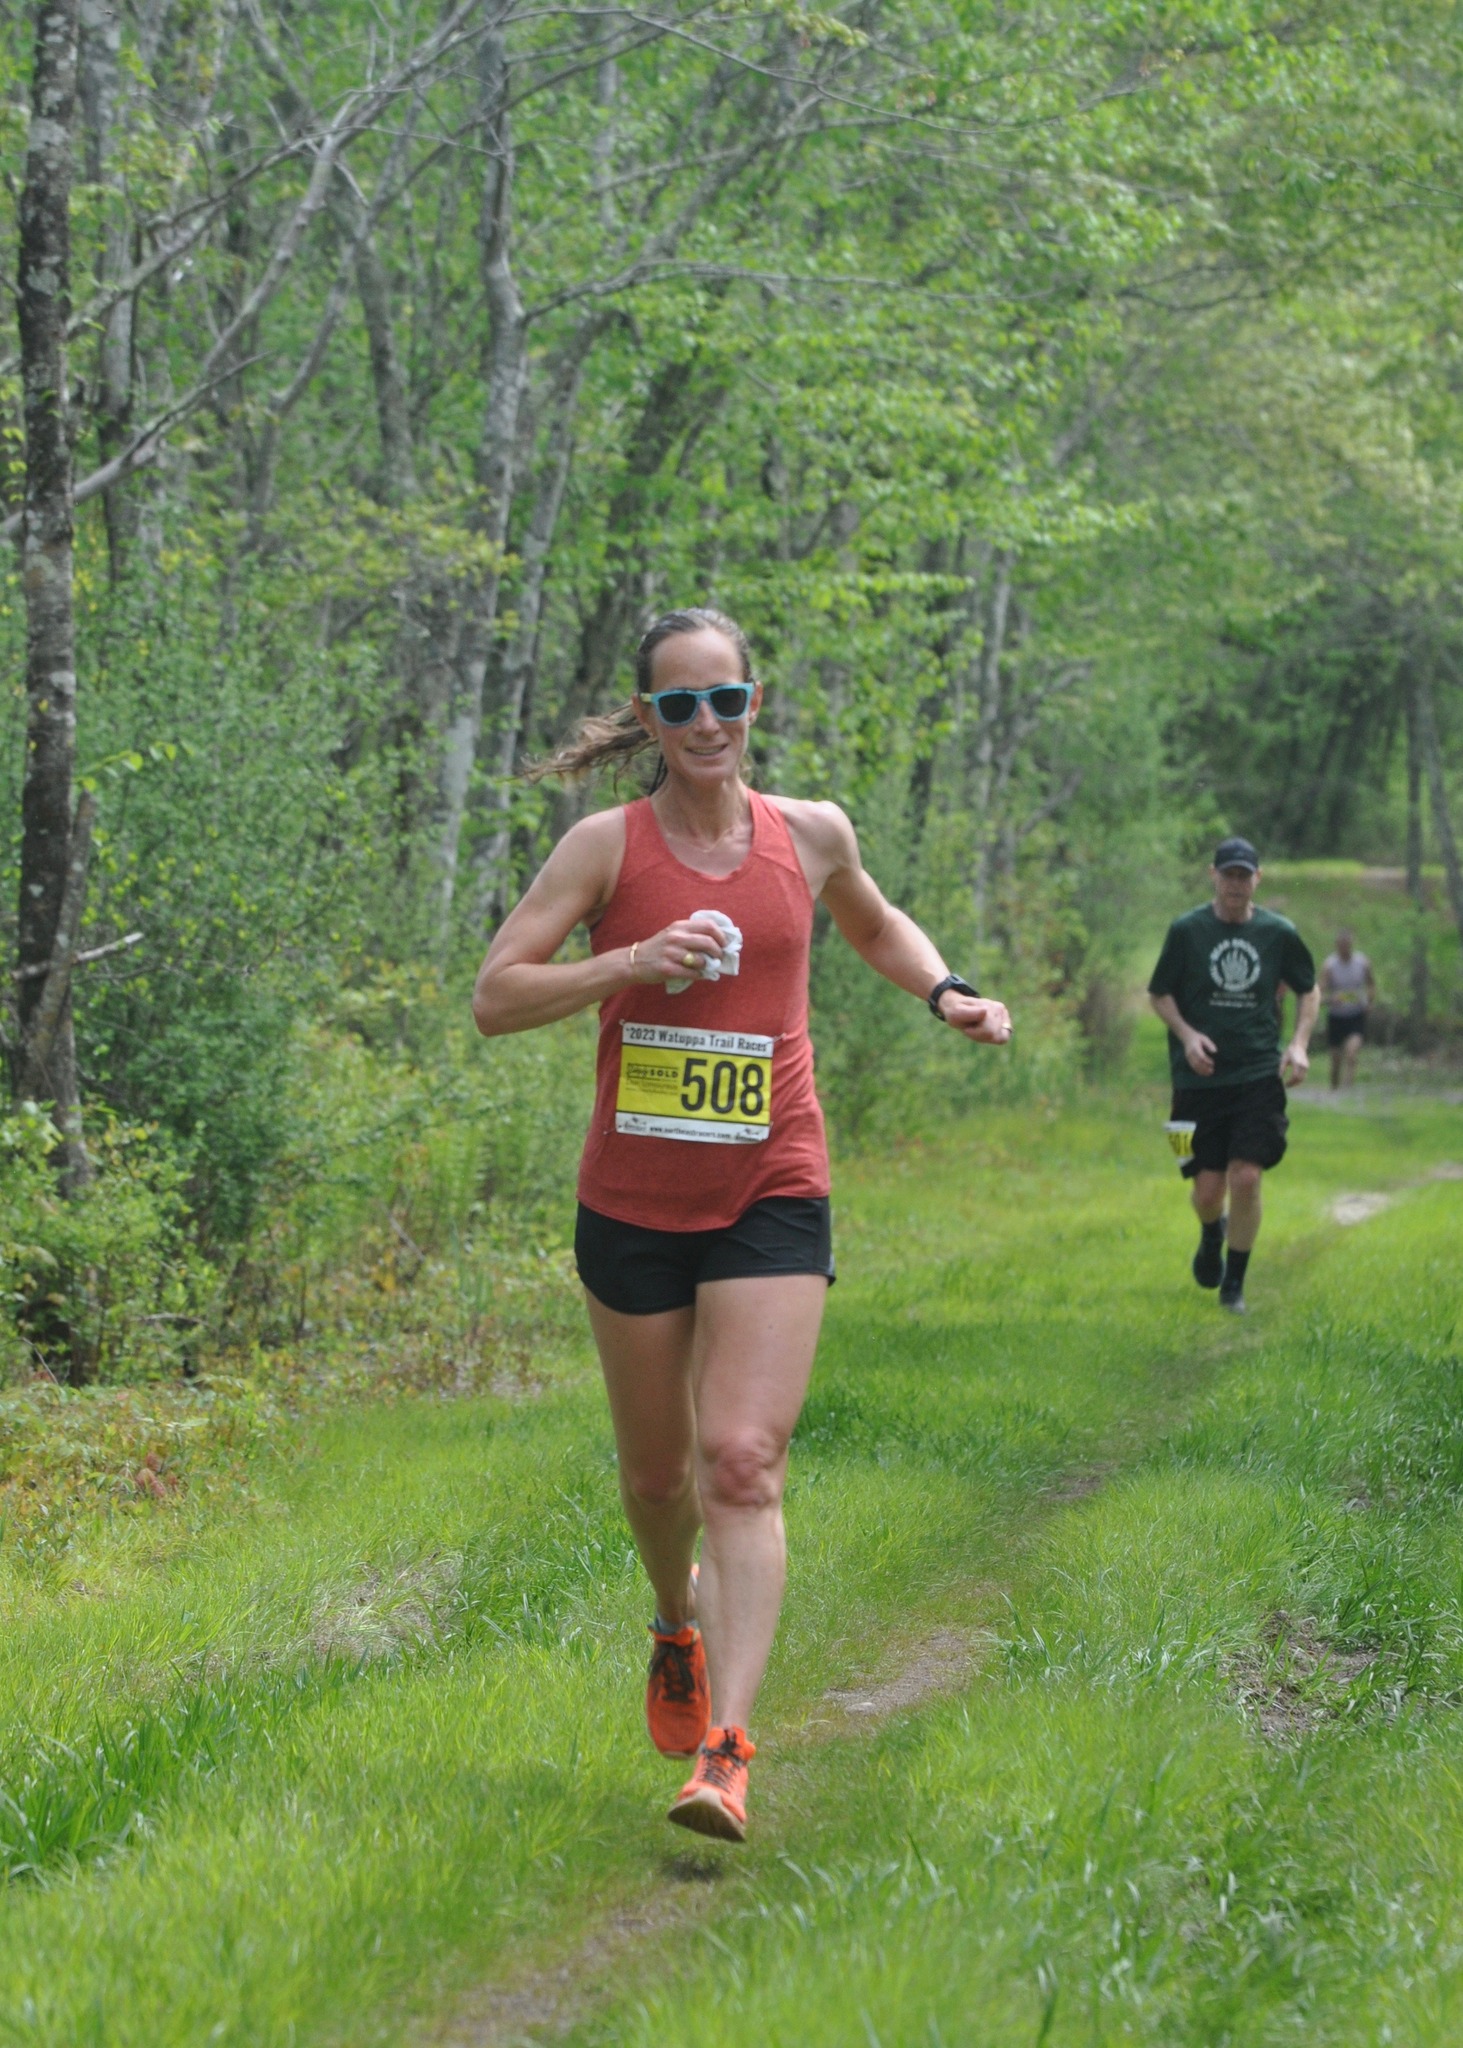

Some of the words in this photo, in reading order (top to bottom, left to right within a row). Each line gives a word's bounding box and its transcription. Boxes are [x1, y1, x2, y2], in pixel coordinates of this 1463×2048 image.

[629, 1026, 656, 1041] 2023
[658, 1029, 706, 1047] Watuppa
[709, 1034, 735, 1049] Trail
[737, 1037, 767, 1052] Races
[681, 1057, 764, 1117] 508
